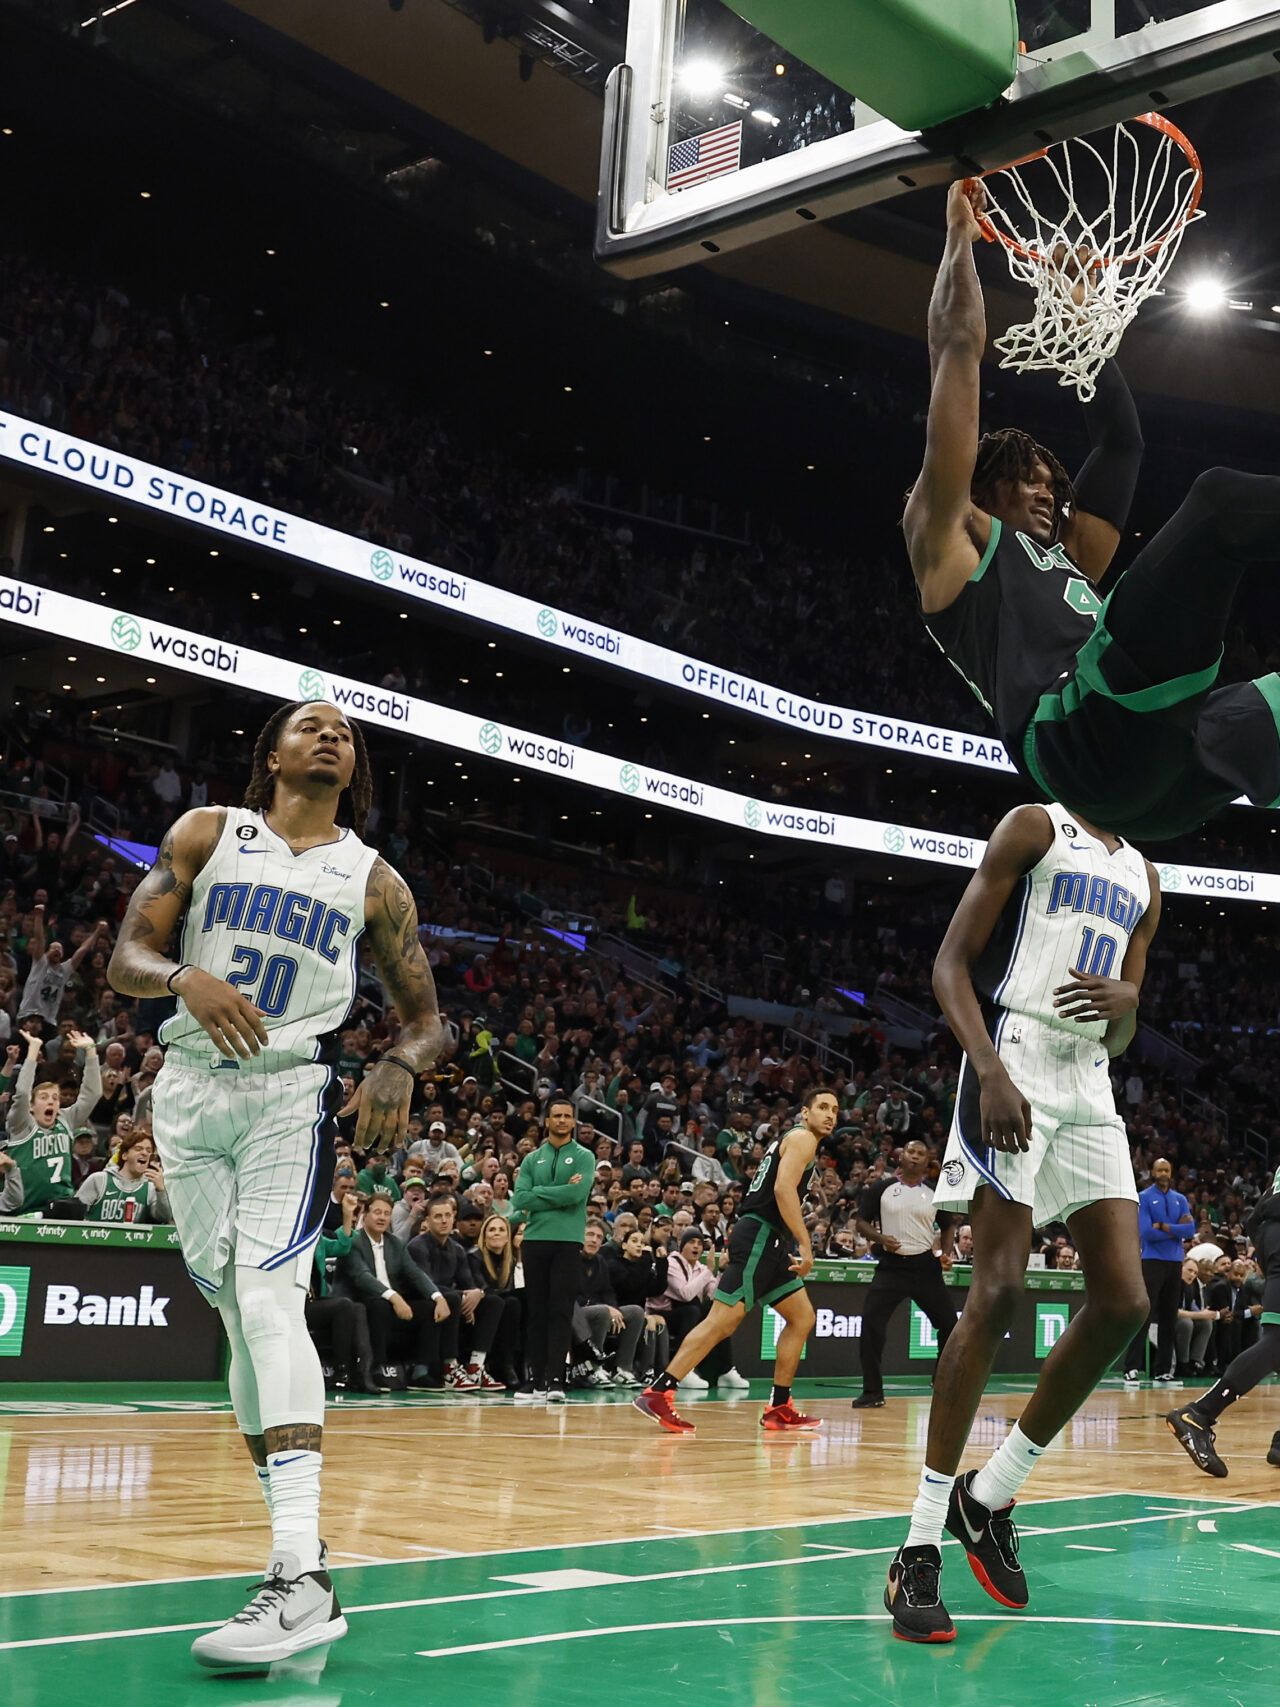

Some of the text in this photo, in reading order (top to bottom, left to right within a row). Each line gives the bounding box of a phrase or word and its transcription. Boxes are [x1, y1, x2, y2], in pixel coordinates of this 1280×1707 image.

[20, 432, 288, 544] CLOUD STORAGE
[398, 564, 467, 602] wasabi
[149, 628, 238, 674] wasabi
[562, 621, 620, 656] wasabi
[332, 682, 410, 723] wasabi
[682, 663, 768, 710] OFFICIAL
[775, 696, 844, 732] CLOUD
[852, 716, 954, 754] STORAGE
[508, 734, 574, 770] wasabi
[644, 774, 704, 807] wasabi
[240, 828, 253, 838] 6
[766, 806, 836, 836] wasabi
[910, 835, 974, 860] wasabi
[321, 861, 352, 881] Disney
[1186, 870, 1254, 894] wasabi
[202, 882, 350, 965] MAGIC
[1076, 926, 1118, 980] 10
[226, 945, 298, 1018] 20
[32, 1132, 70, 1160] BOSTON
[46, 1156, 64, 1184] 7
[101, 1199, 142, 1223] BOS
[37, 1225, 66, 1238] xfinity
[44, 1285, 170, 1327] Bank
[1039, 1314, 1066, 1348] TD
